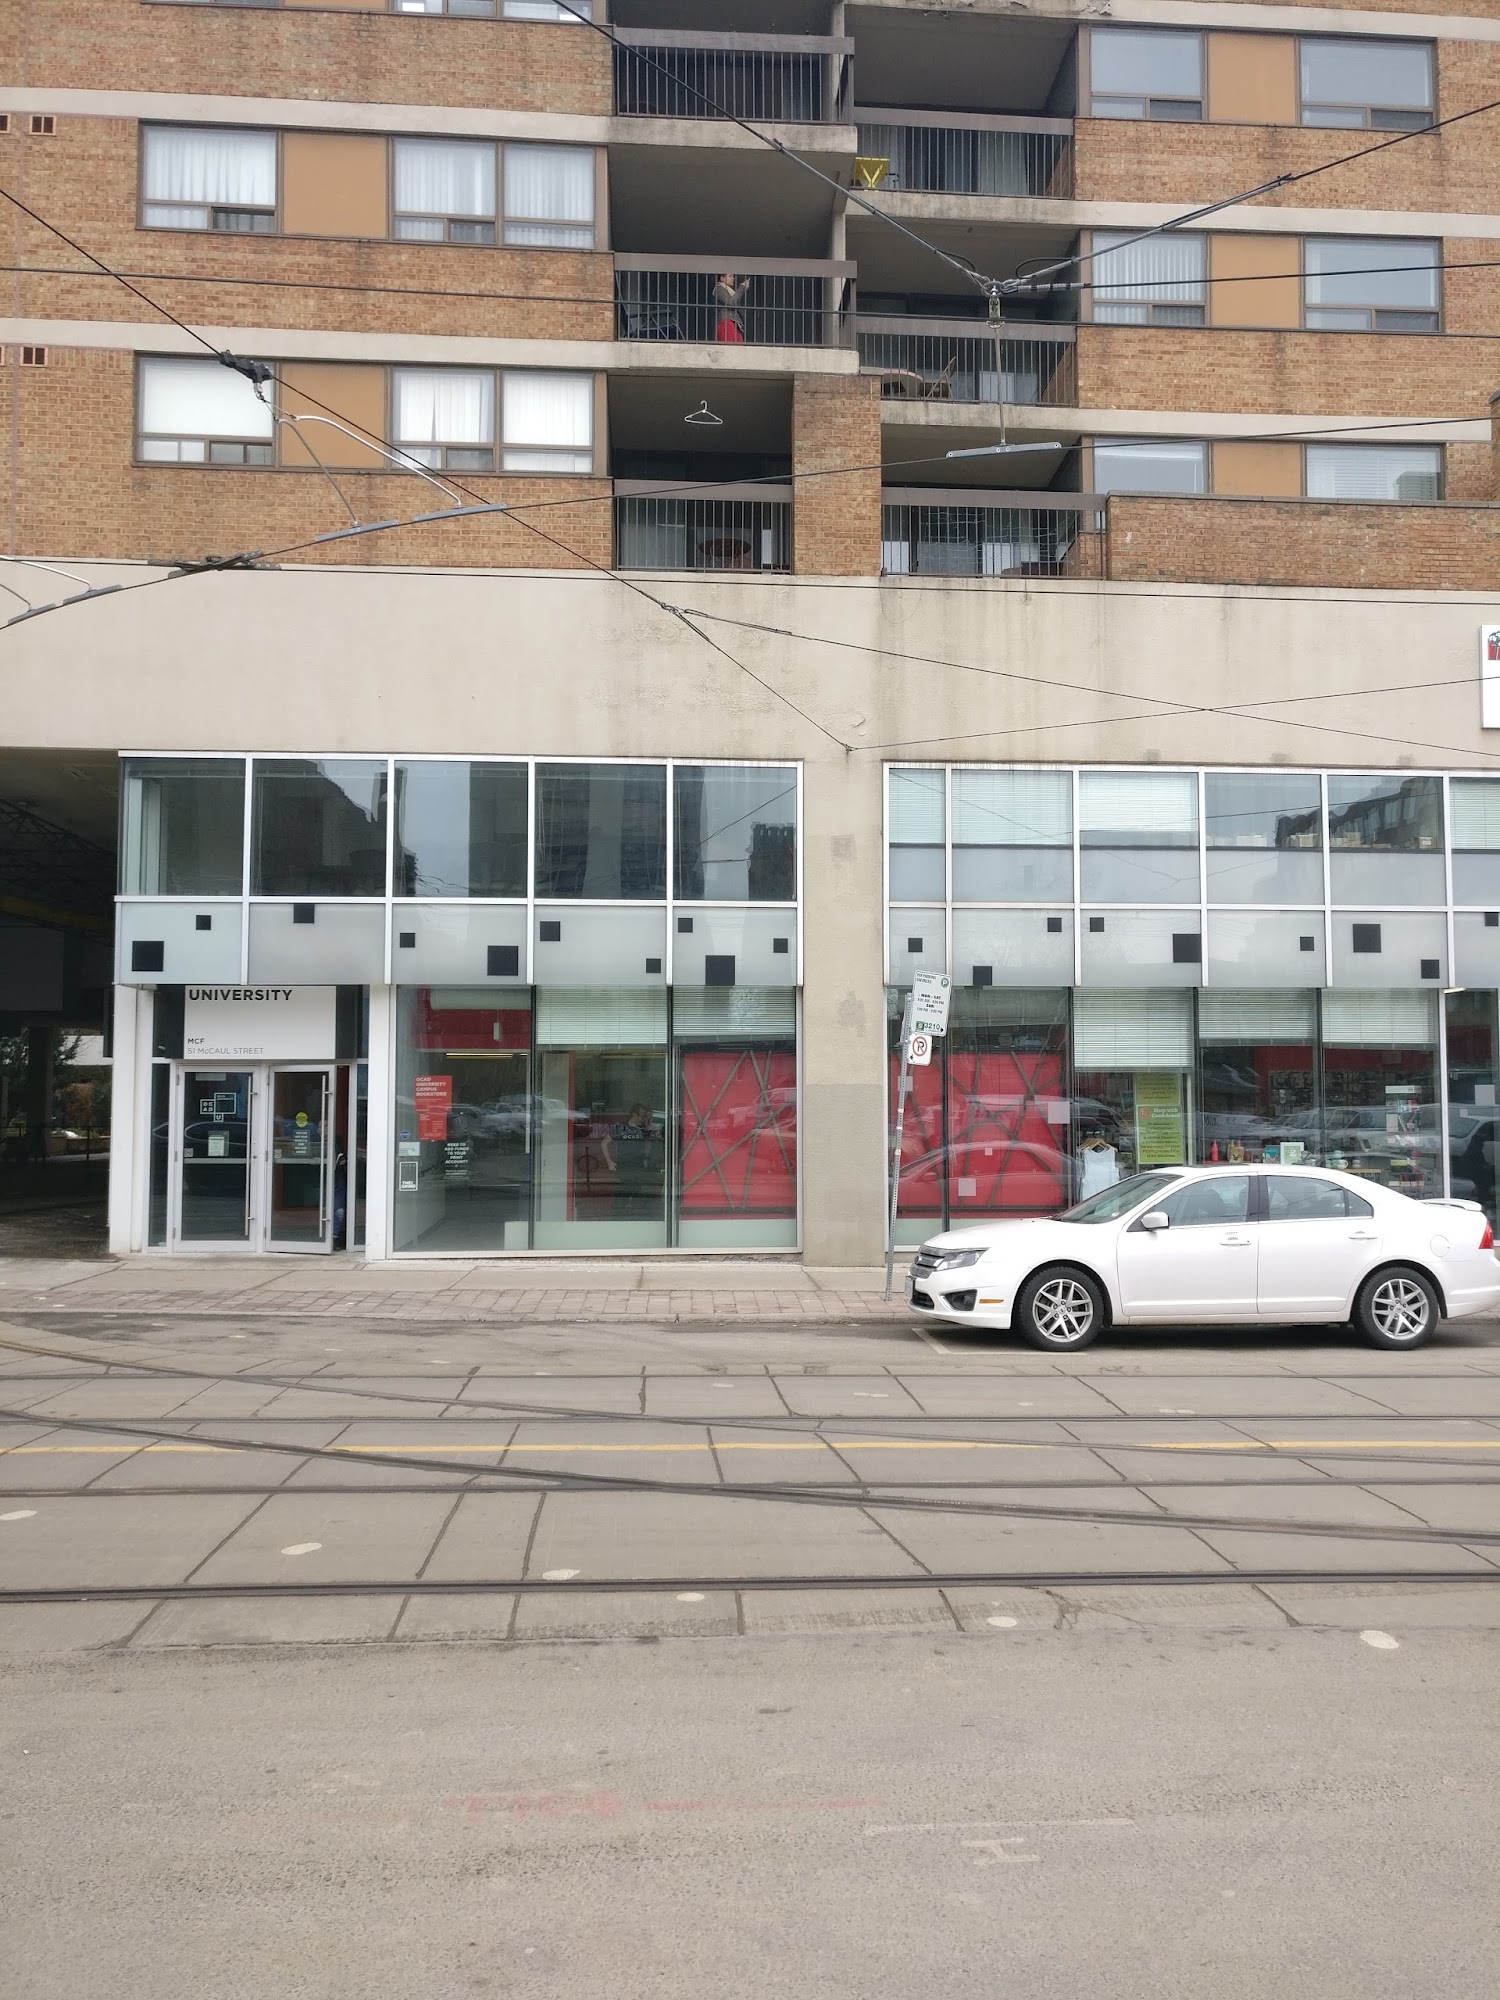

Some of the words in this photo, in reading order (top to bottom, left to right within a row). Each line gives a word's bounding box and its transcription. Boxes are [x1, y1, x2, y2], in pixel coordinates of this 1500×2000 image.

[189, 989, 293, 1001] UNIVERSITY
[924, 1022, 941, 1030] 3210
[187, 1037, 205, 1045] MCF
[187, 1047, 196, 1055] 51
[197, 1047, 231, 1055] McCAUL
[233, 1047, 264, 1055] STREET
